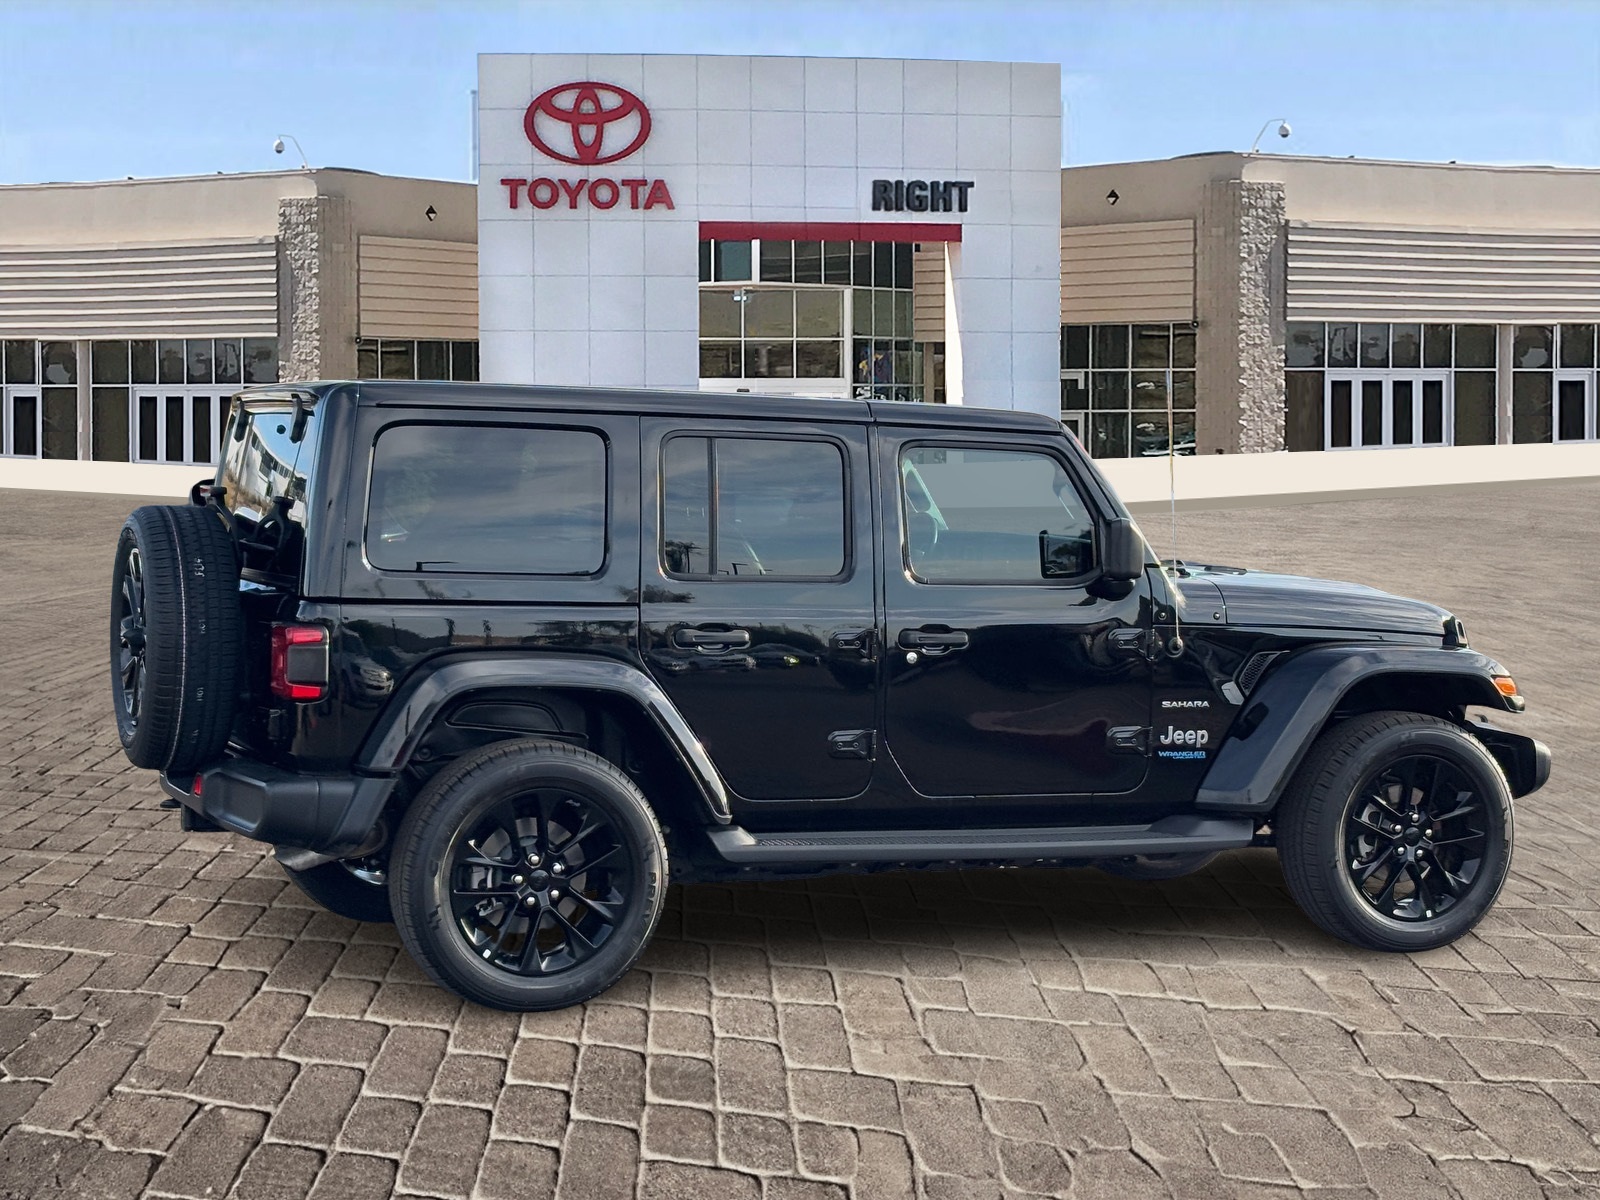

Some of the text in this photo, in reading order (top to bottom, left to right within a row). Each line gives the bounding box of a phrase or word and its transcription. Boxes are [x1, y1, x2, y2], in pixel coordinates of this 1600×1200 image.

[500, 177, 675, 210] TOYOTA
[871, 179, 975, 212] RIGHT
[1160, 725, 1209, 748] Jeep
